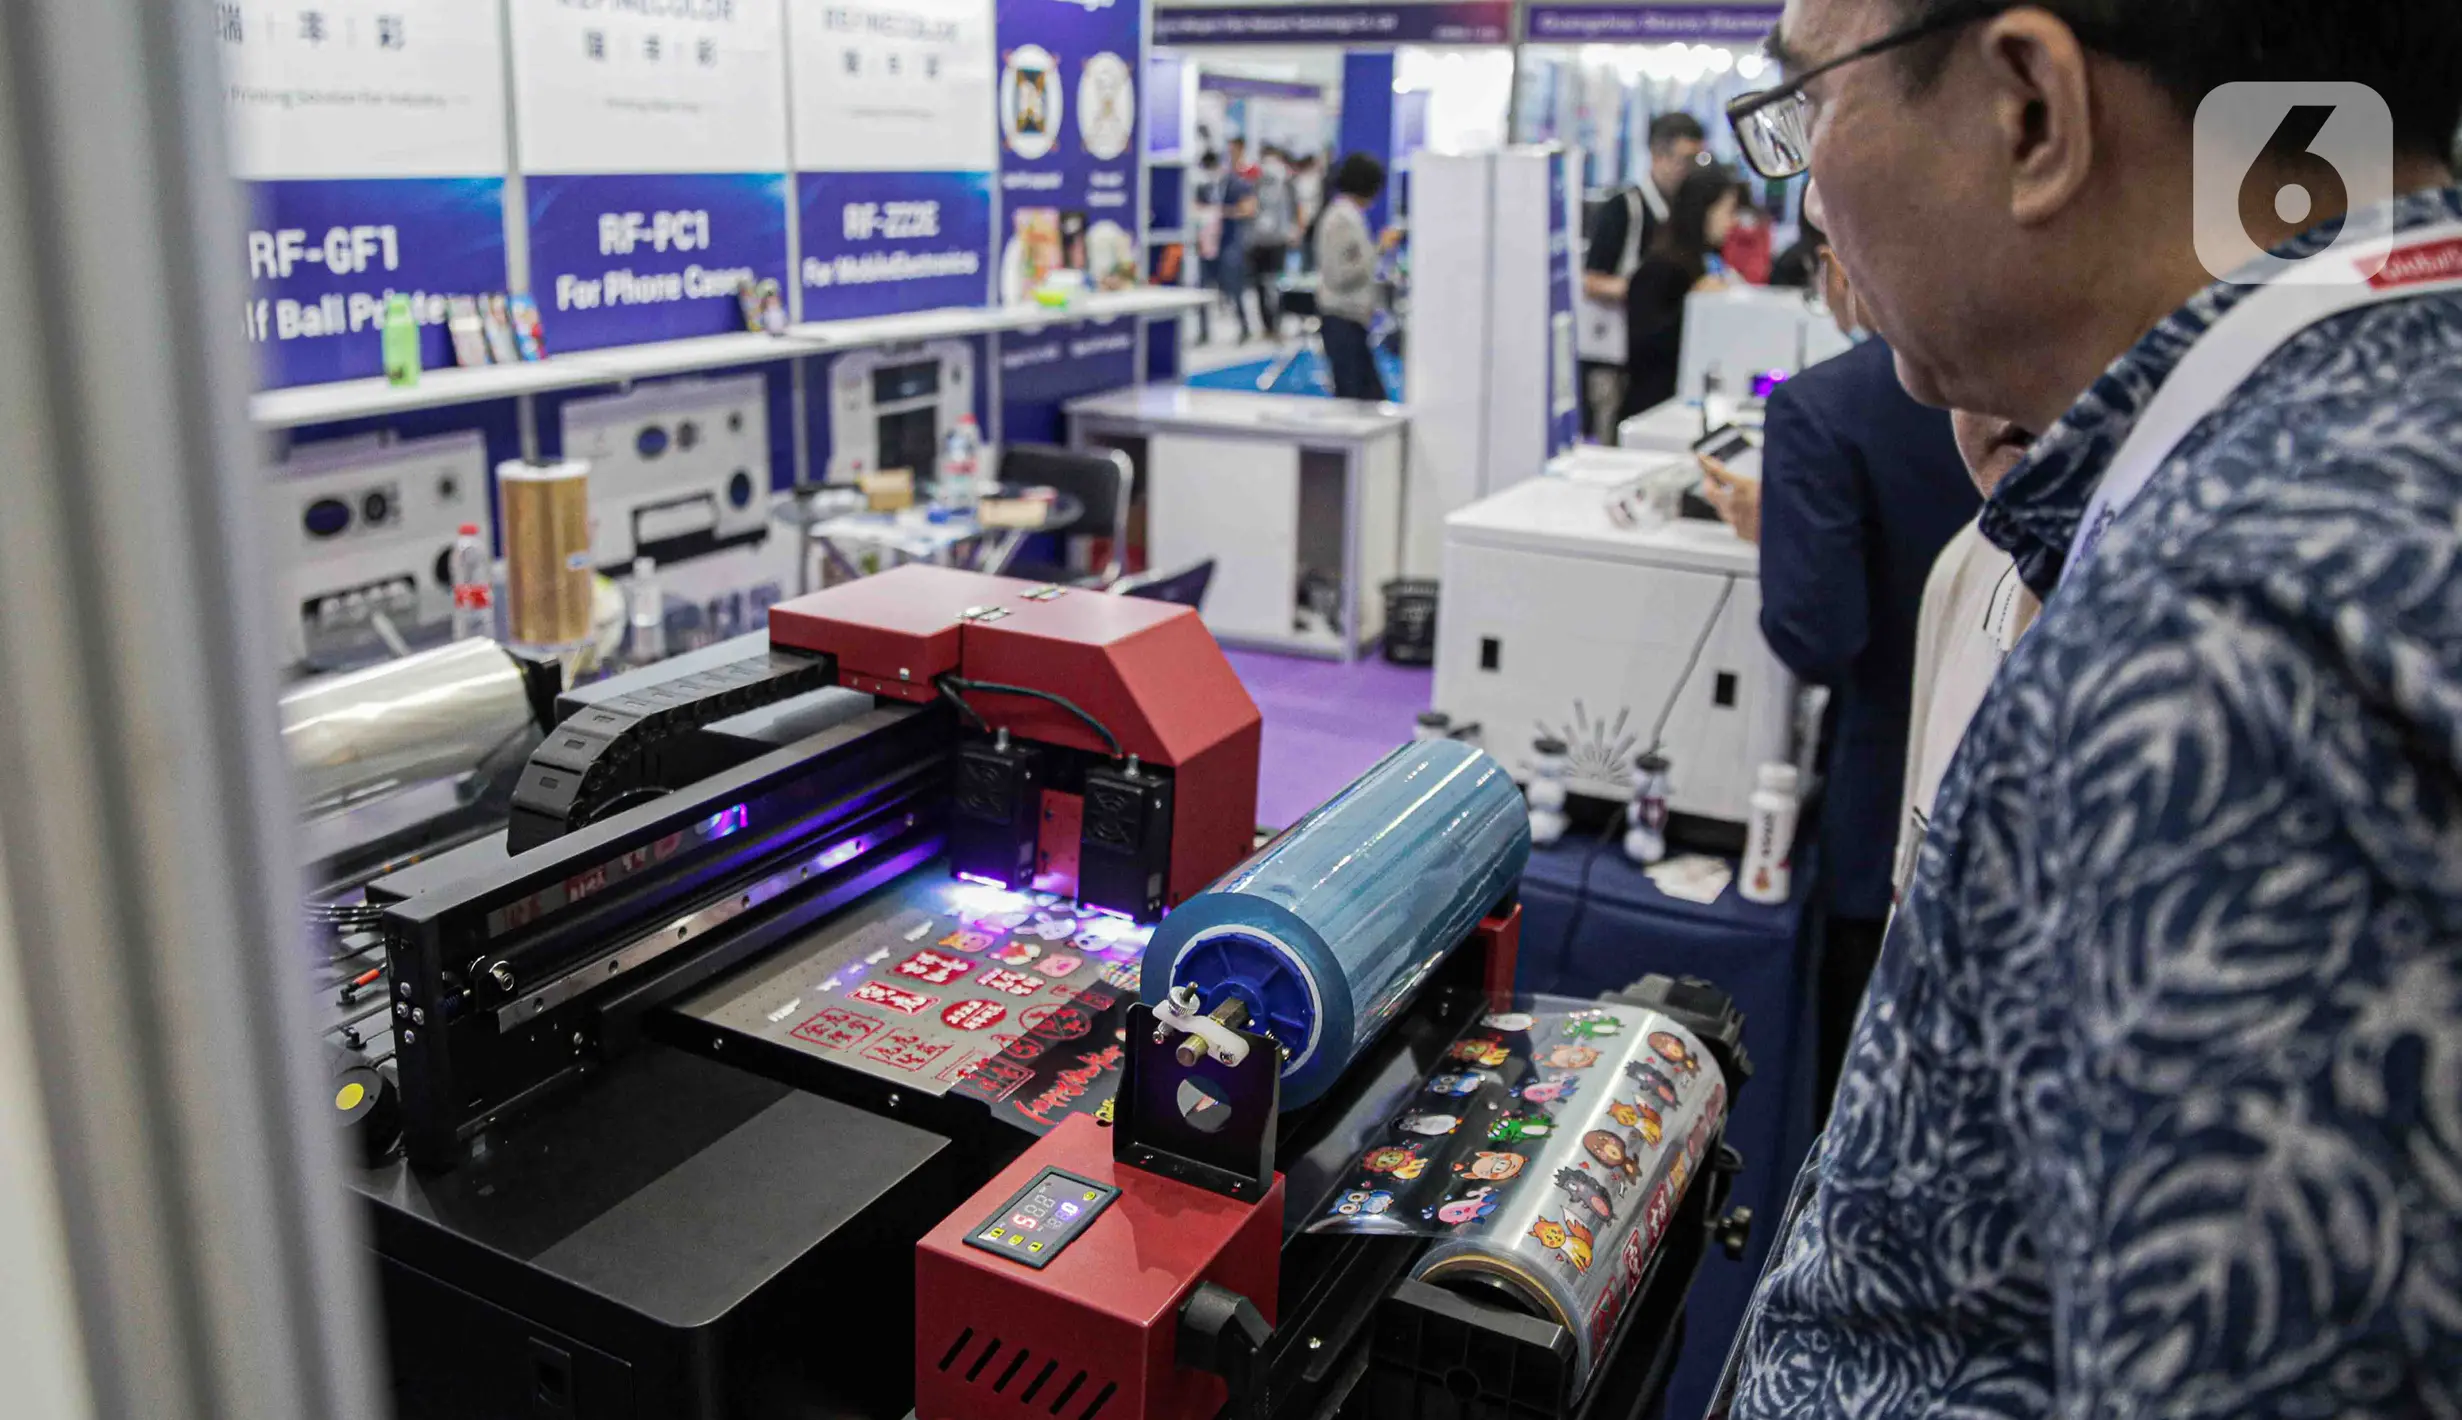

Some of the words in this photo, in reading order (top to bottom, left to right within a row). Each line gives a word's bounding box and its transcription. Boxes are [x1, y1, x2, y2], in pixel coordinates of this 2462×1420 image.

[248, 225, 399, 280] RF-GF1
[599, 210, 710, 255] RF-PC1
[556, 274, 601, 310] For
[603, 269, 682, 306] Phone
[802, 256, 834, 287] For
[276, 293, 347, 340] Ball
